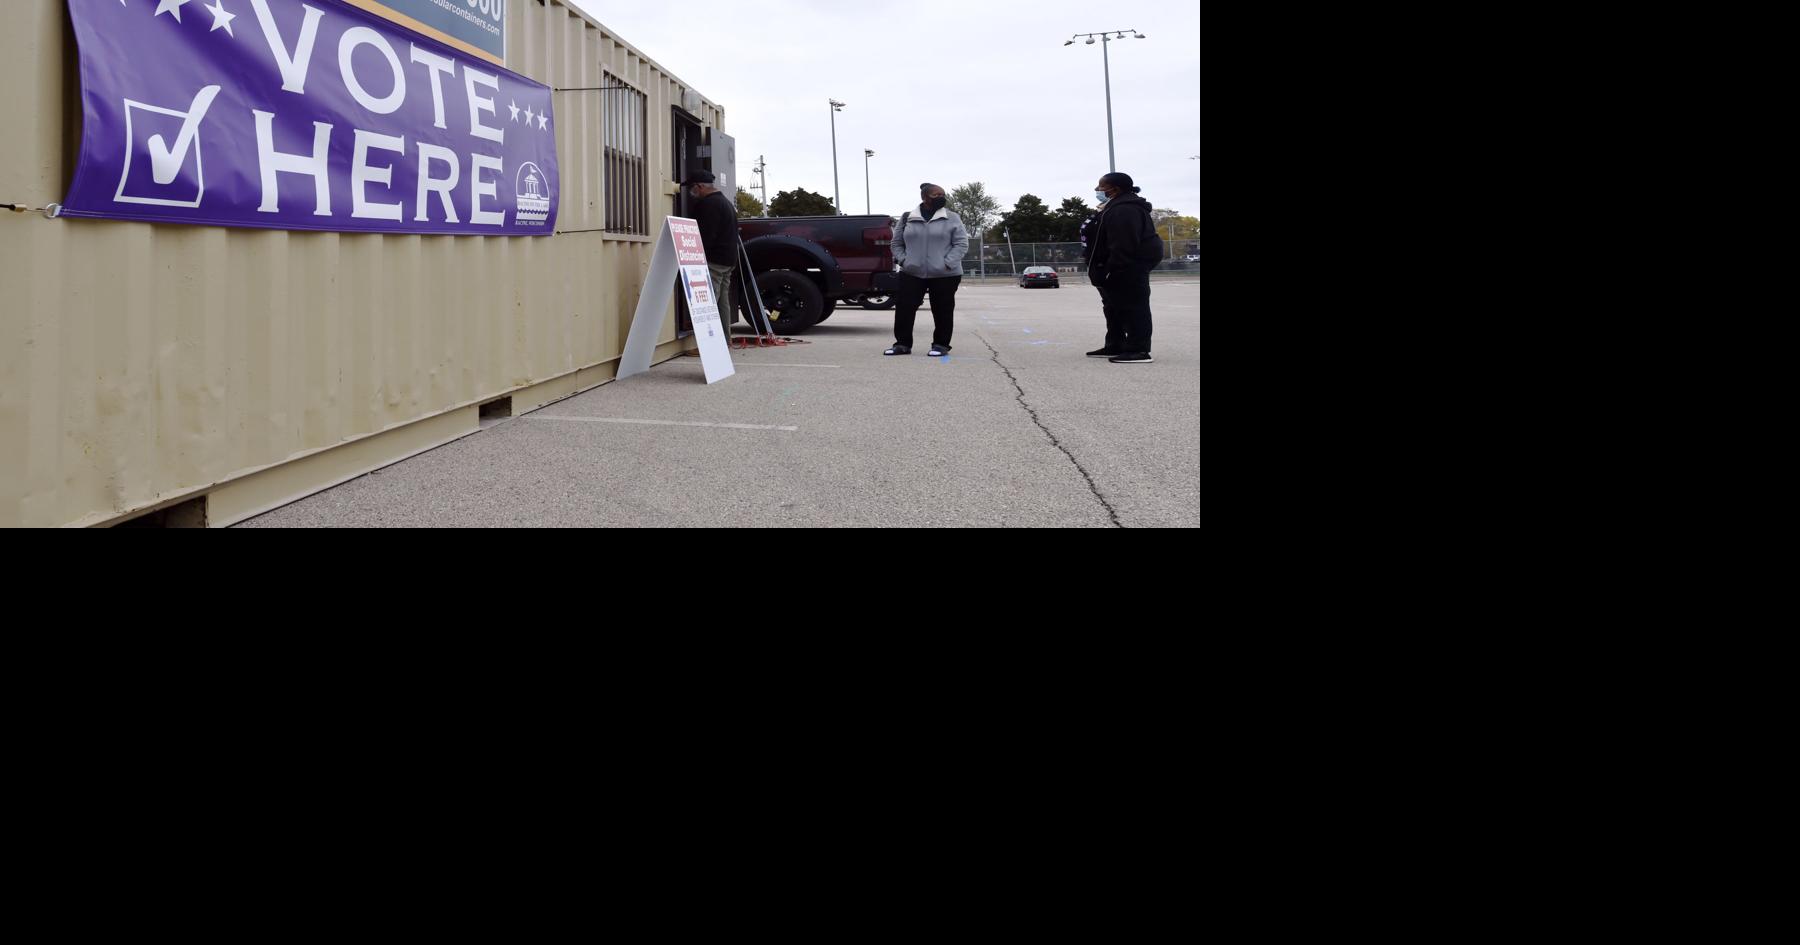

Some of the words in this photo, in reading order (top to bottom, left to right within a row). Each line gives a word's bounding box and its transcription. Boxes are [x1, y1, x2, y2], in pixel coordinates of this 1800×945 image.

[251, 0, 505, 145] VOTE
[253, 109, 506, 227] HERE
[681, 235, 697, 247] Social
